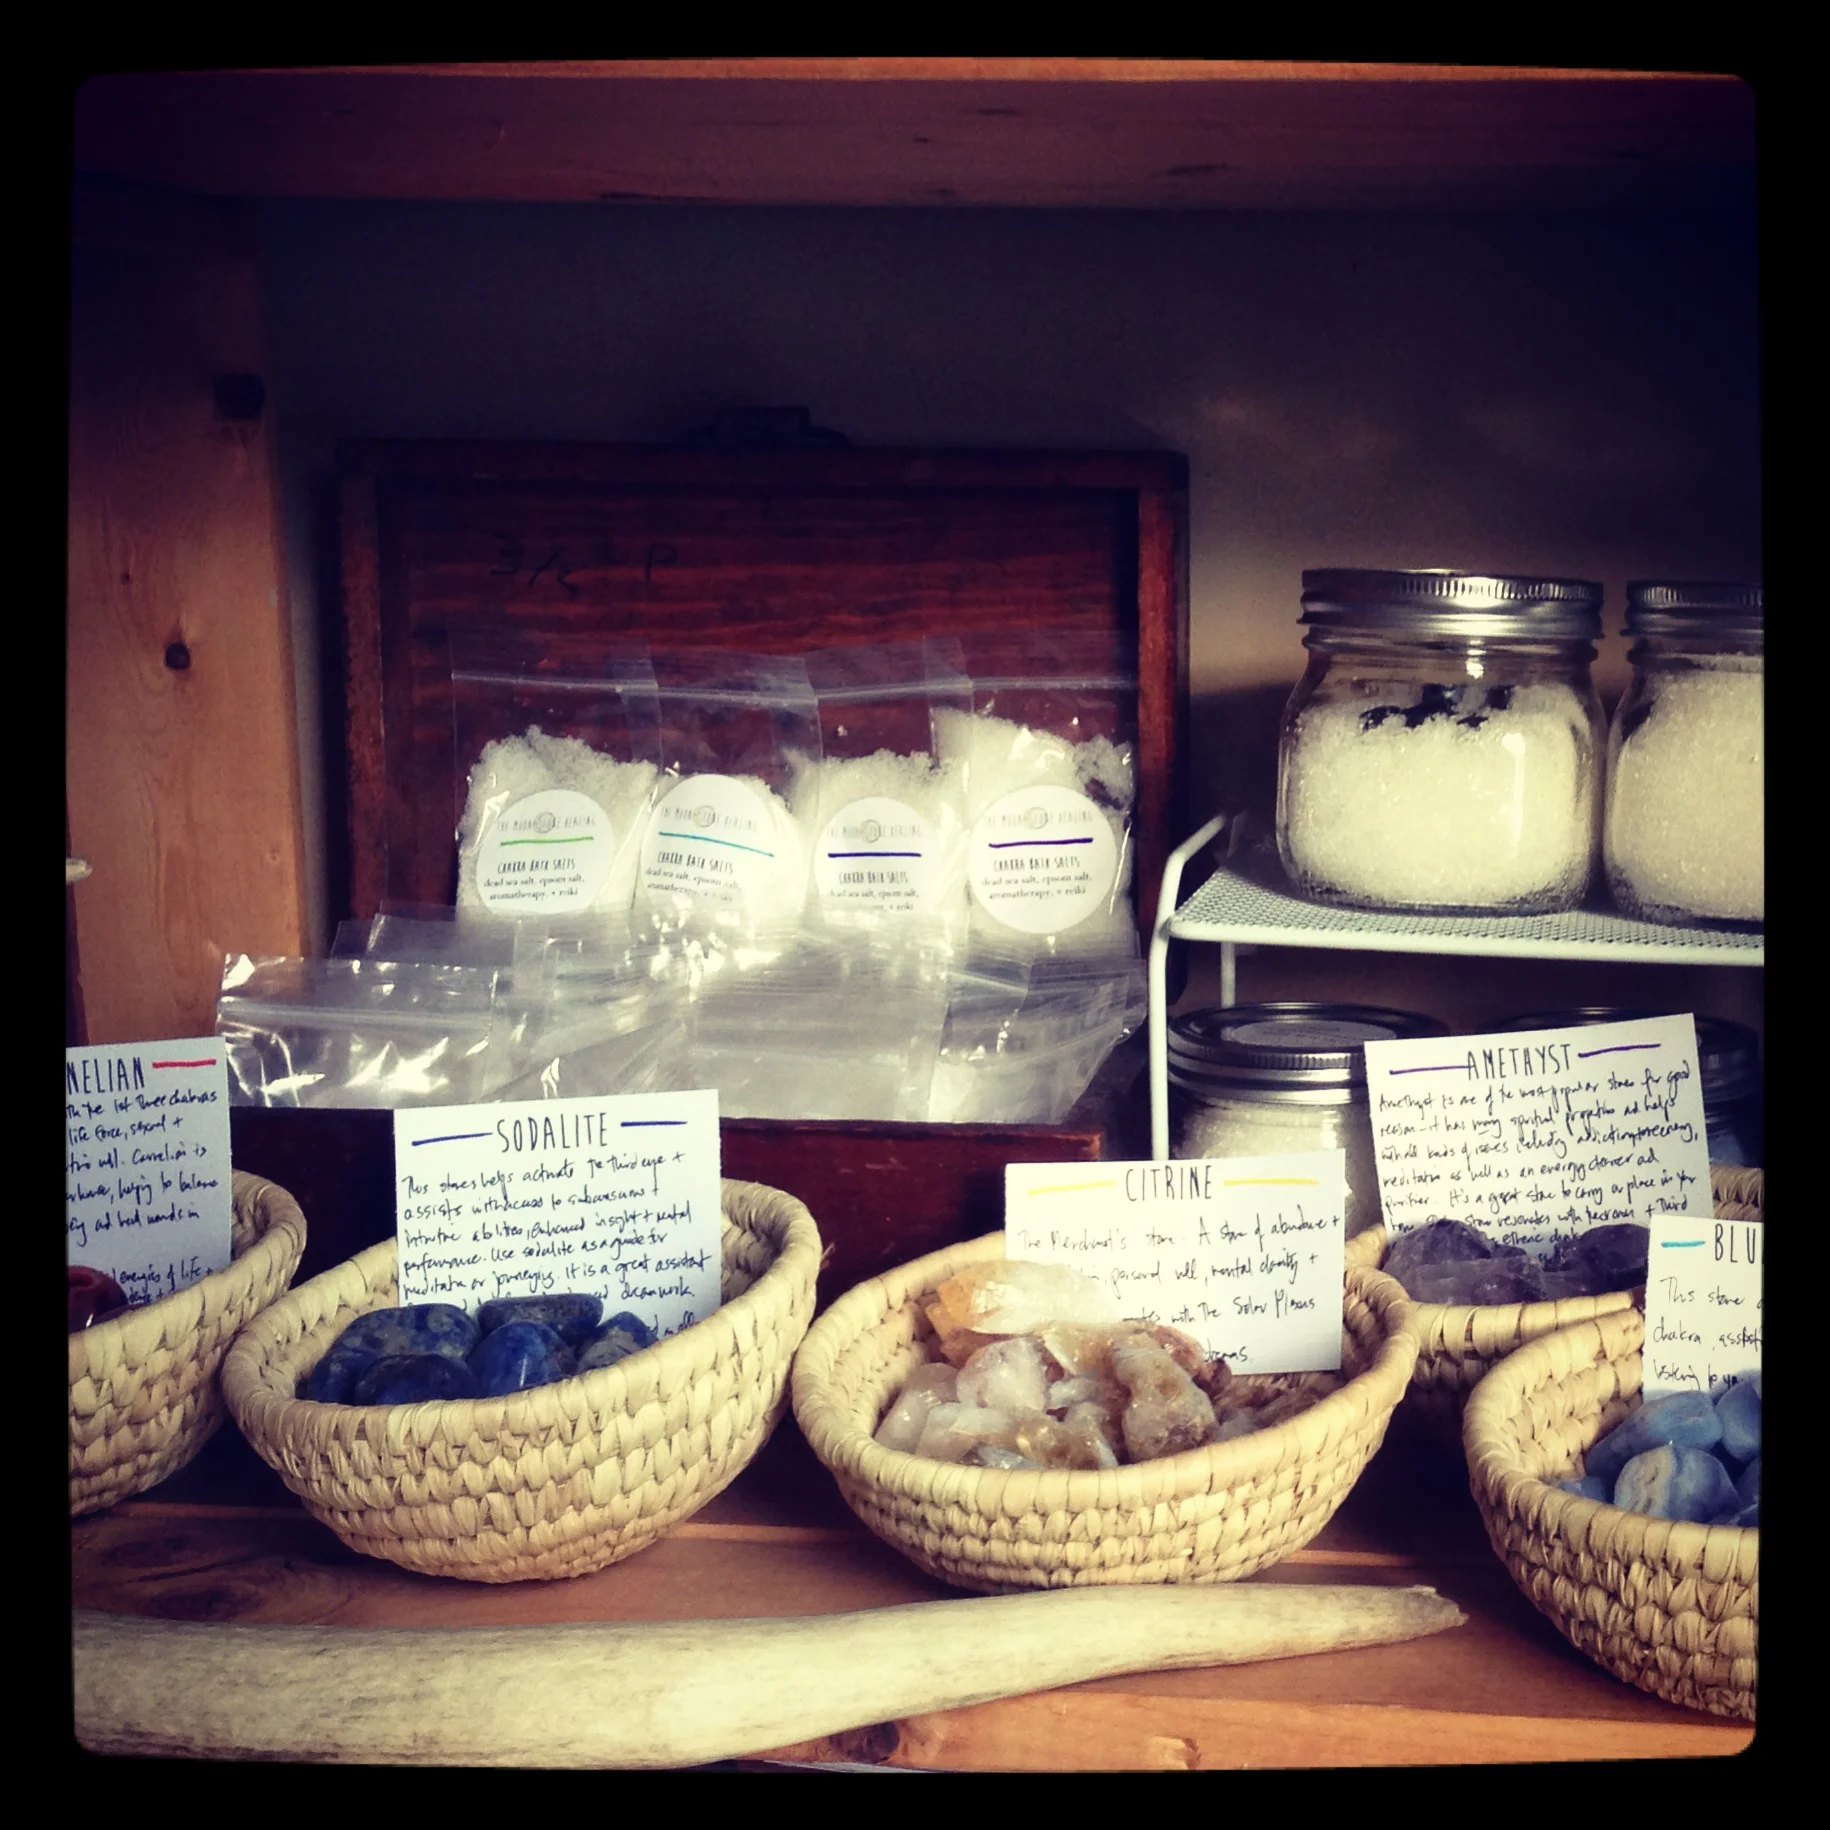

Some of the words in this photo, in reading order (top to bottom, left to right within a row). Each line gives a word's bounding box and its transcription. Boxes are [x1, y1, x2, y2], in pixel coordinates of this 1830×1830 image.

[66, 1056, 145, 1095] NELIAN
[1467, 1043, 1573, 1080] AMETHYST
[1379, 1091, 1436, 1120] Amethyst
[1666, 1059, 1691, 1100] good
[1444, 1115, 1466, 1132] has
[1644, 1094, 1676, 1123] helps
[496, 1112, 608, 1154] SODALITE
[160, 1171, 172, 1193] to
[480, 1169, 514, 1201] helps
[606, 1153, 638, 1173] third
[641, 1154, 667, 1189] eye
[672, 1151, 686, 1163] +
[1124, 1164, 1213, 1202] CITRINE
[1475, 1193, 1485, 1204] a
[1626, 1174, 1656, 1205] place
[1496, 1166, 1510, 1179] as
[1519, 1165, 1535, 1178] an
[403, 1198, 463, 1221] assists
[551, 1193, 562, 1211] to
[594, 1209, 642, 1234] insight
[1497, 1210, 1551, 1228] resonates
[491, 1246, 516, 1262] Use
[522, 1240, 576, 1259] sodalite
[609, 1228, 645, 1260] guide
[1017, 1228, 1042, 1251] The
[1050, 1226, 1127, 1251] Merchant's
[1198, 1215, 1212, 1246] A
[1332, 1214, 1341, 1228] +
[471, 1278, 486, 1291] or
[565, 1262, 580, 1279] It
[583, 1262, 597, 1277] is
[600, 1264, 611, 1276] a
[615, 1252, 652, 1284] great
[654, 1248, 713, 1273] assistant
[1111, 1259, 1162, 1301] personal
[1308, 1252, 1319, 1265] +
[1232, 1295, 1268, 1316] Solar
[1274, 1287, 1316, 1320] Plexus
[1707, 1284, 1746, 1307] stone
